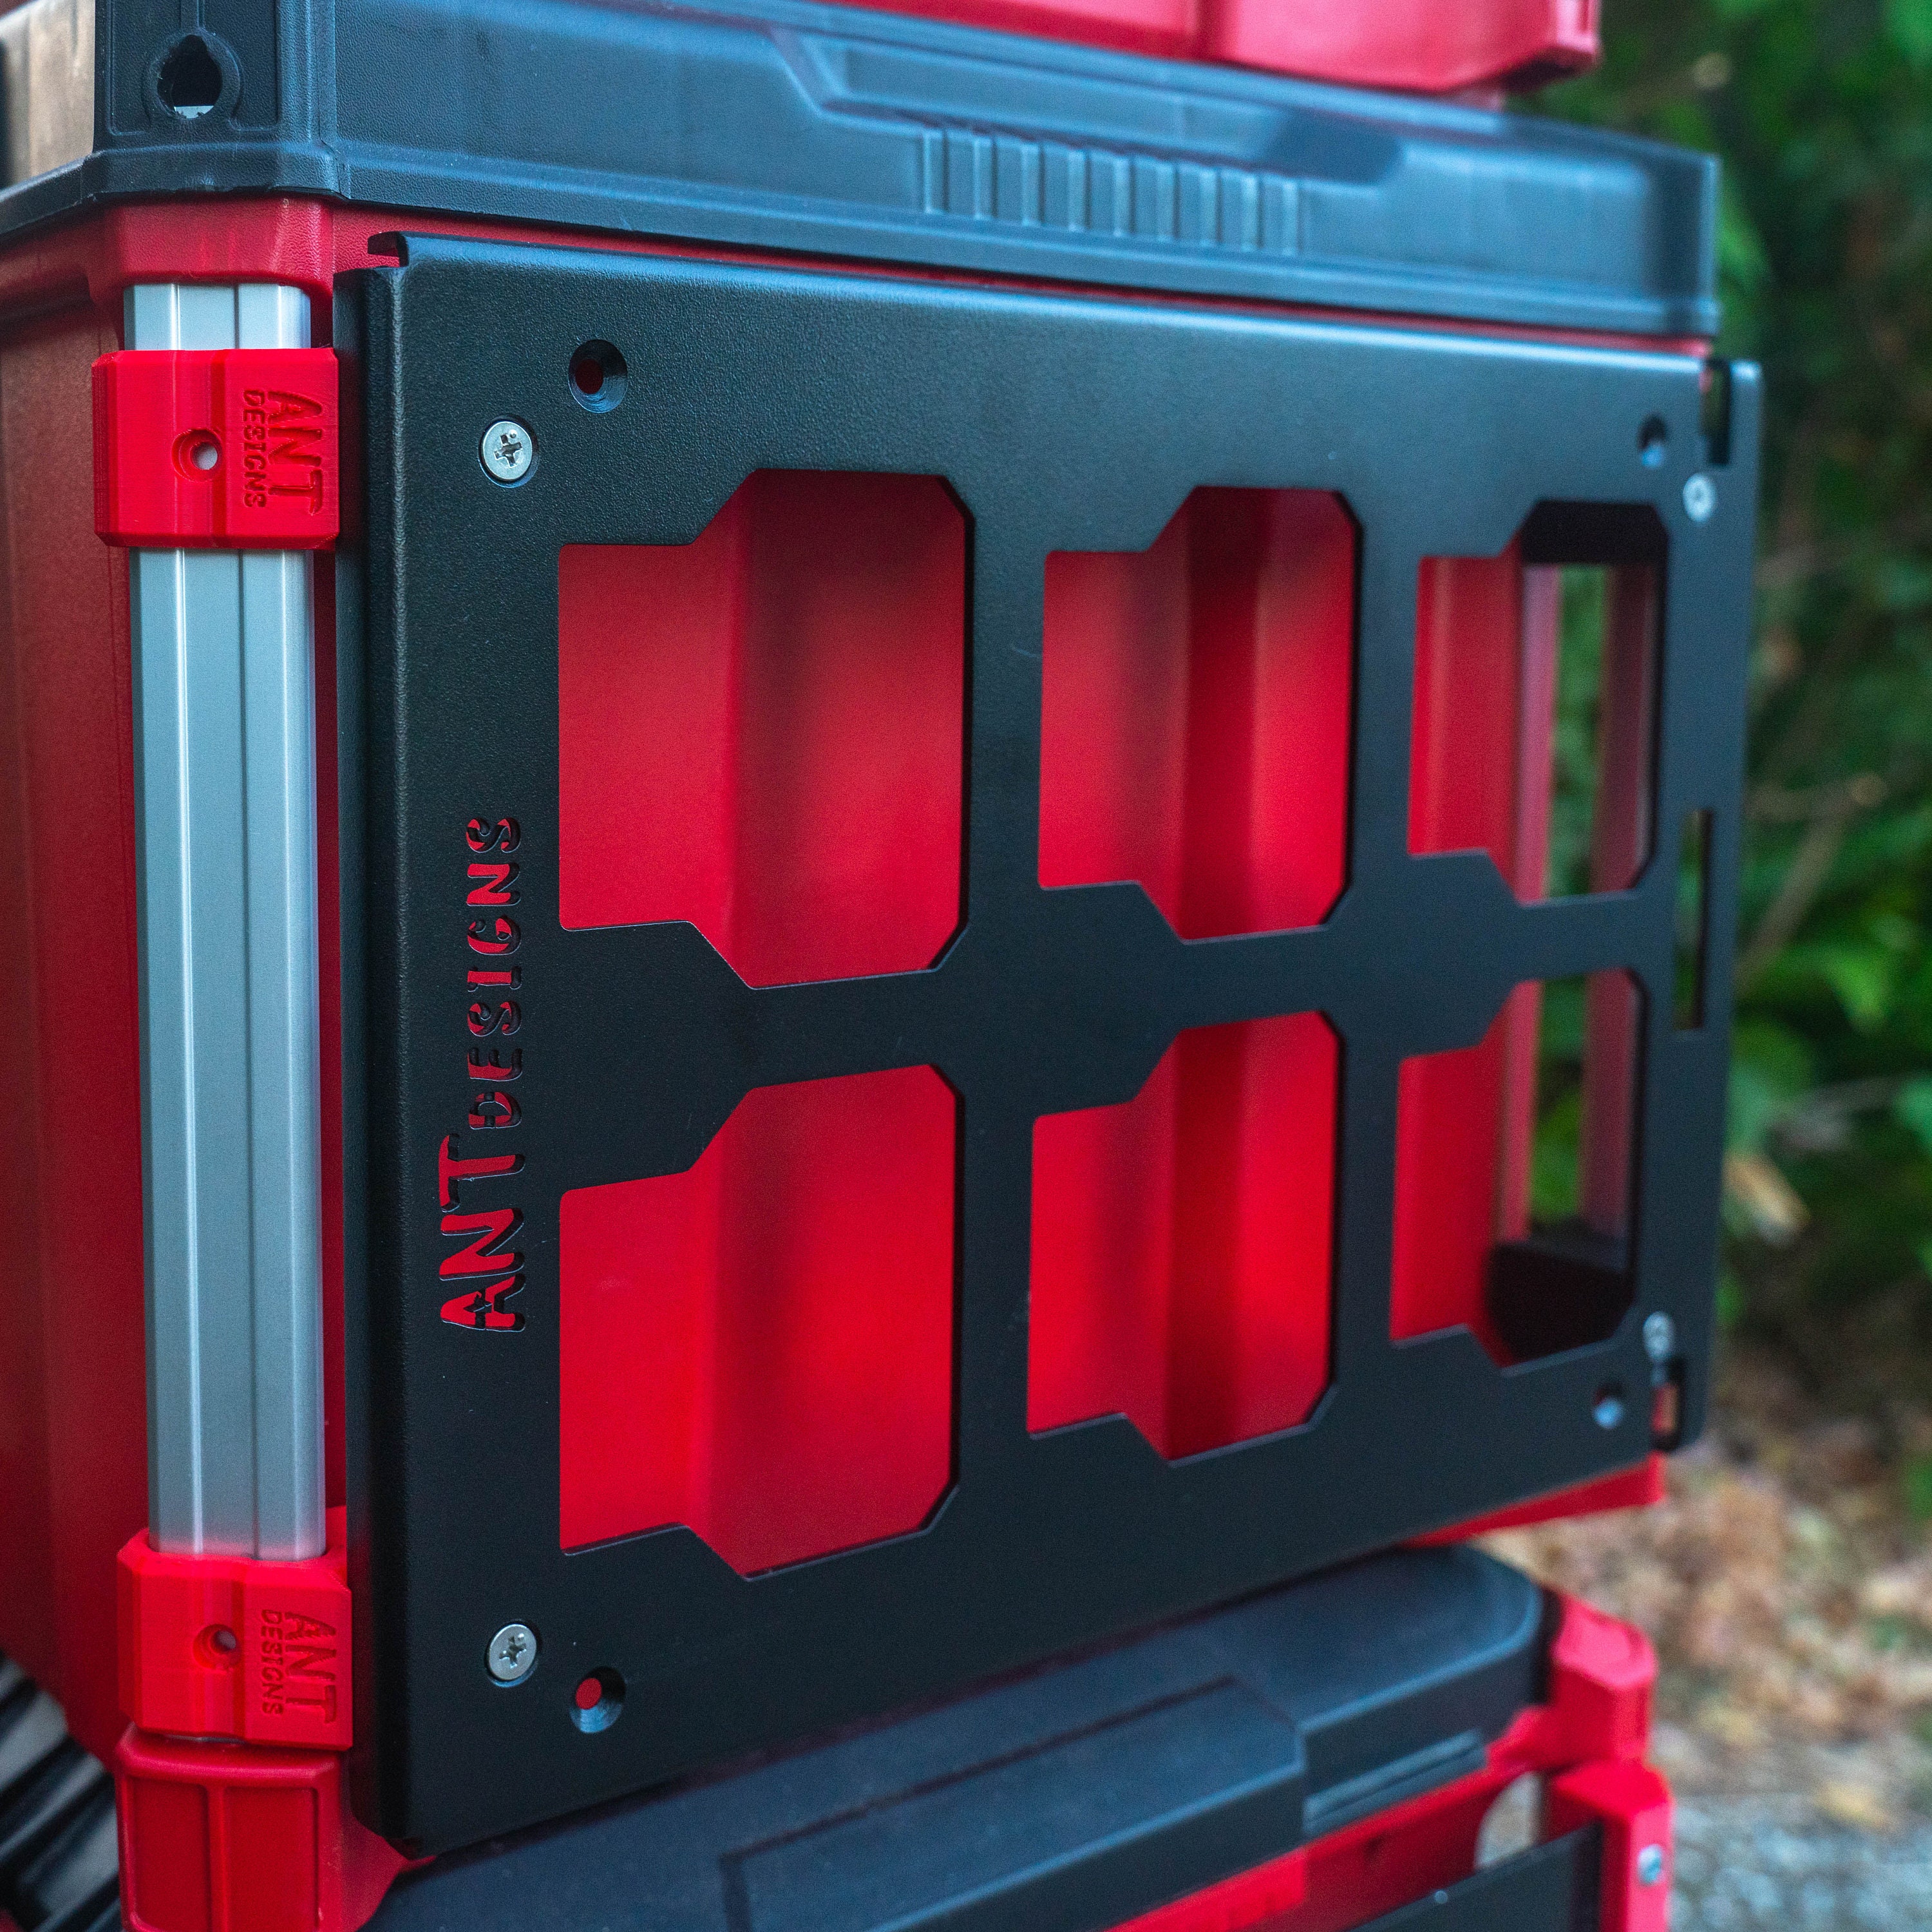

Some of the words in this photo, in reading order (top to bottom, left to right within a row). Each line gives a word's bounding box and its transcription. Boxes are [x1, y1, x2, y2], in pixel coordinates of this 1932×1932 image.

[243, 389, 267, 507] DESIGNS
[267, 390, 323, 516] ANT
[466, 817, 522, 1130] DESIGNS
[439, 1133, 526, 1332] ANT
[261, 1609, 284, 1714] DESIGNS
[285, 1611, 337, 1723] ANT
